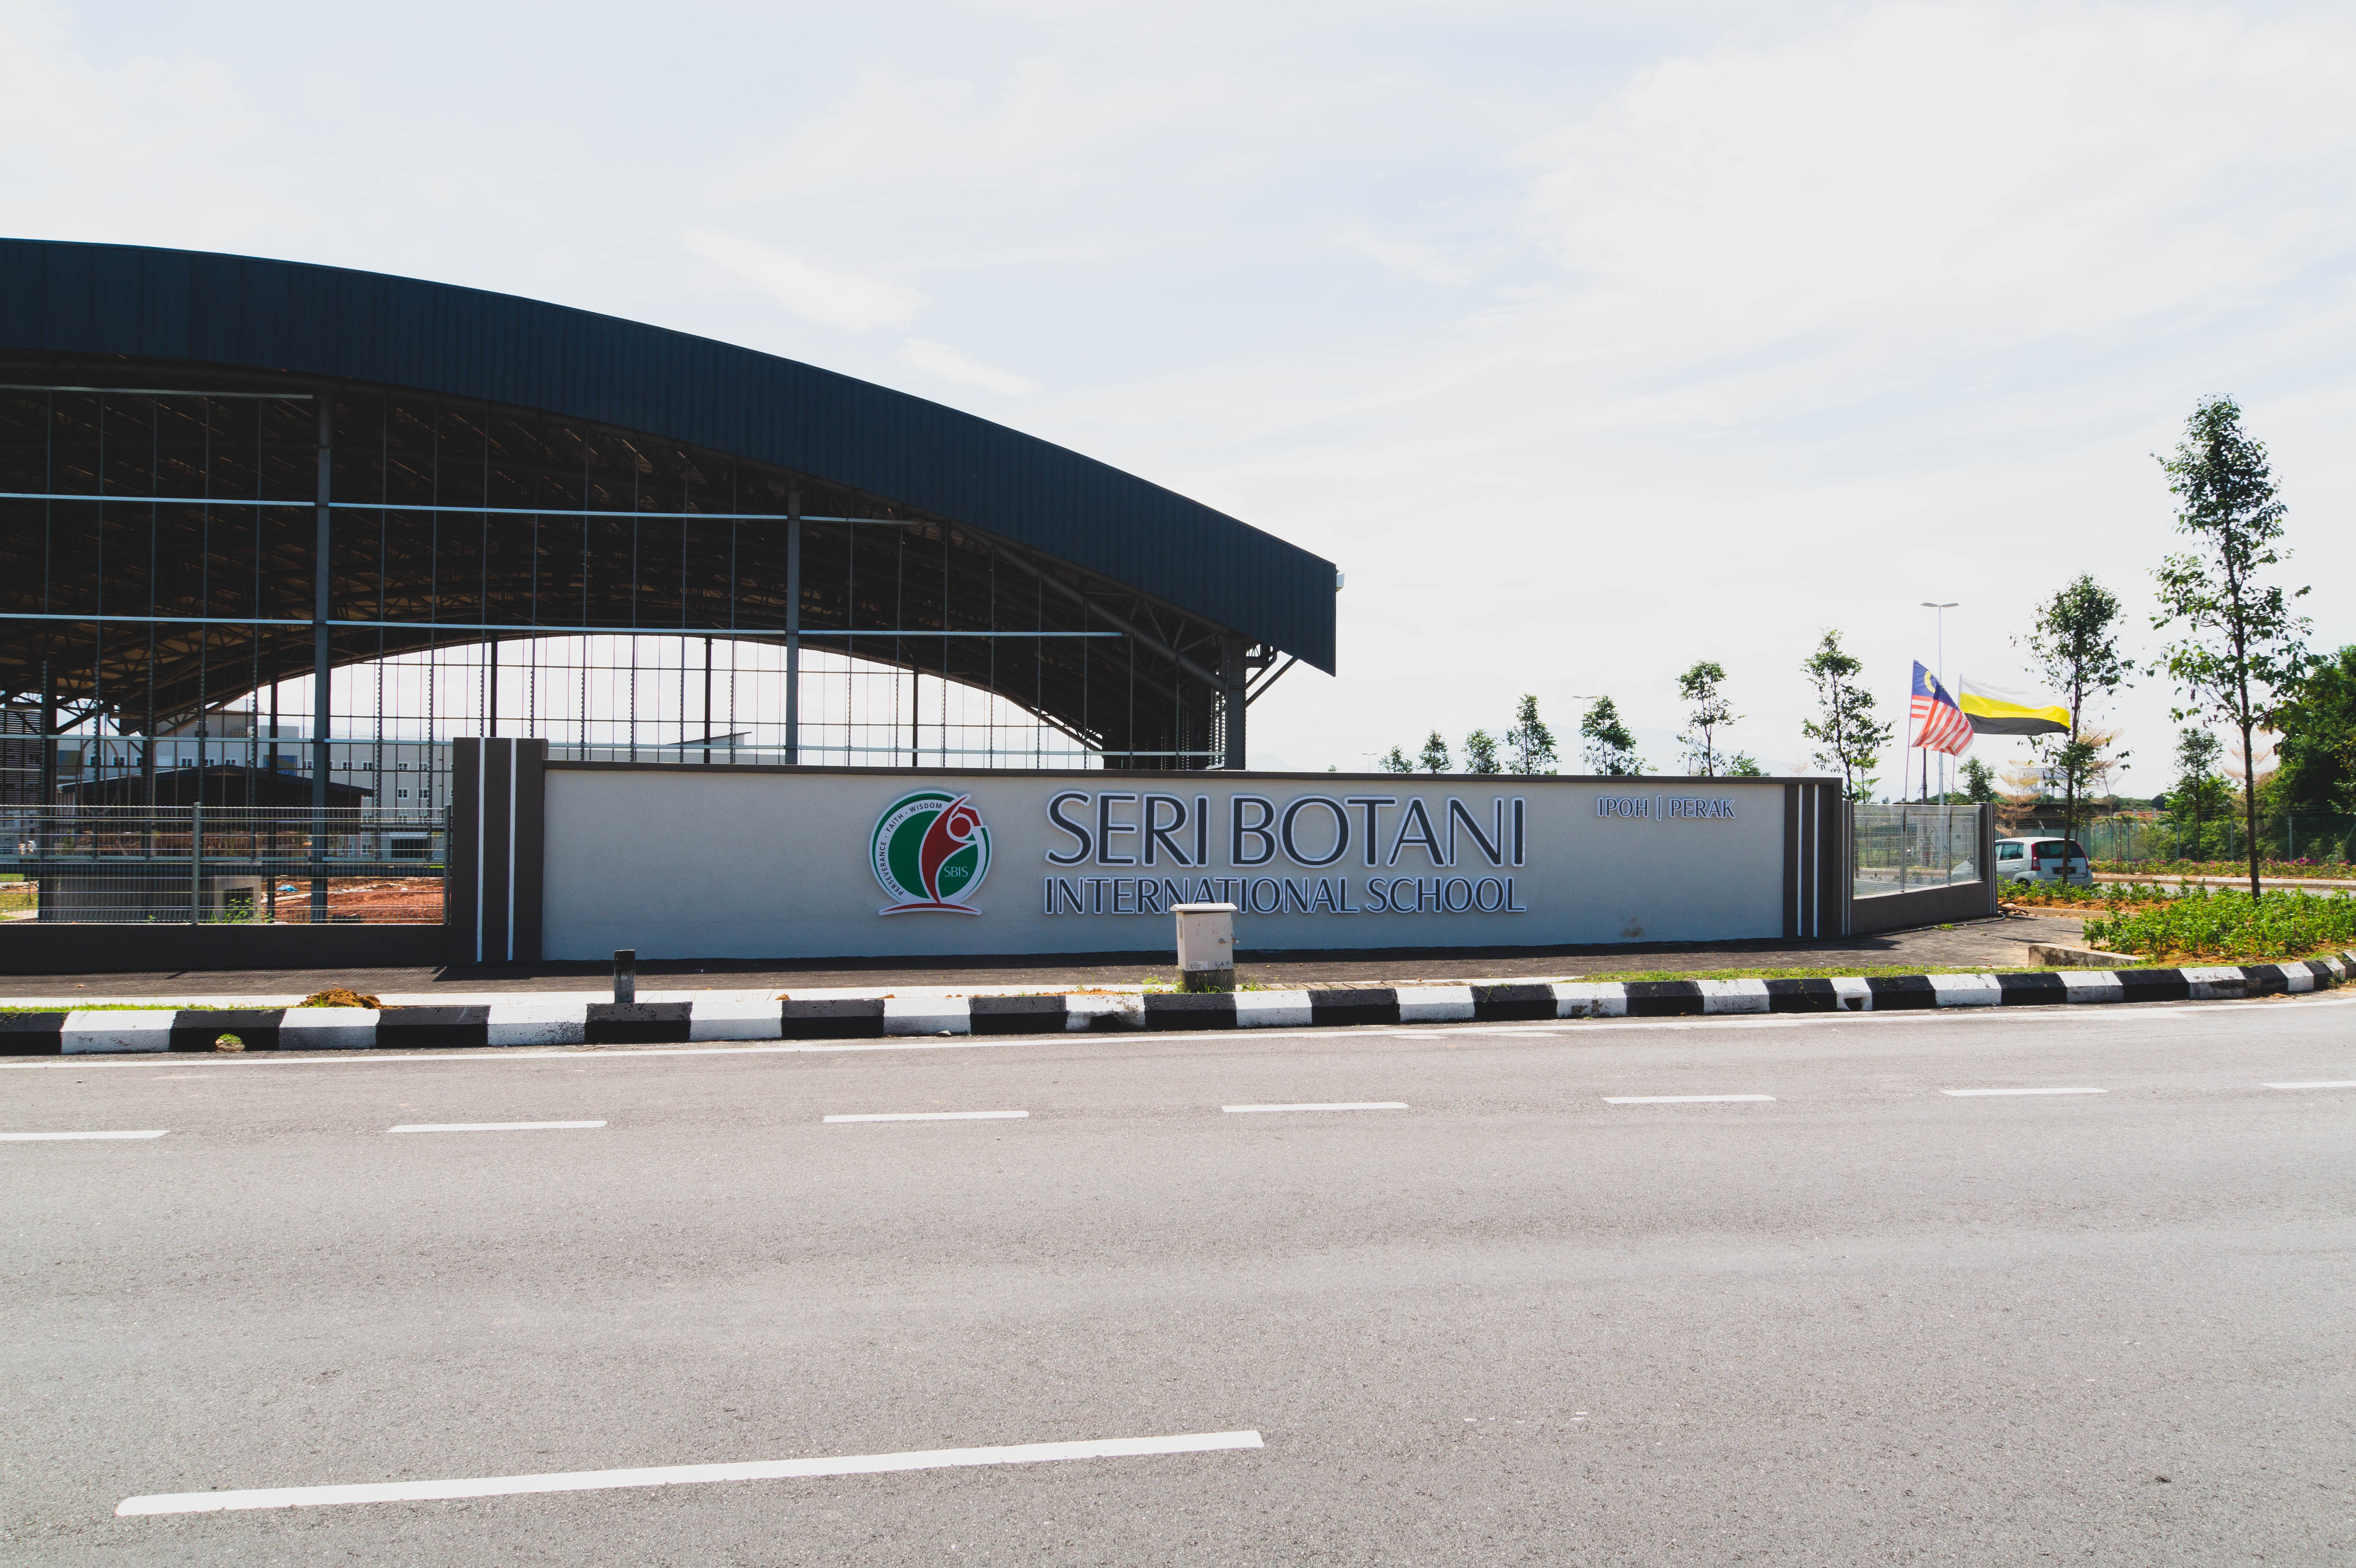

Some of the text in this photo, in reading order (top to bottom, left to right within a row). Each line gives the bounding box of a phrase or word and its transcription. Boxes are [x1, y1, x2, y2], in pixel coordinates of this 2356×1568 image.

[1598, 798, 1649, 818] IPOH
[1669, 799, 1735, 819] PERAK
[1045, 791, 1526, 868] SERI BOTANI
[879, 802, 943, 896] PERSEVERANCE FAITH WISDOM
[944, 866, 968, 877] SBIS
[1045, 876, 1526, 914] INTERNATIONAL SCHOOL
